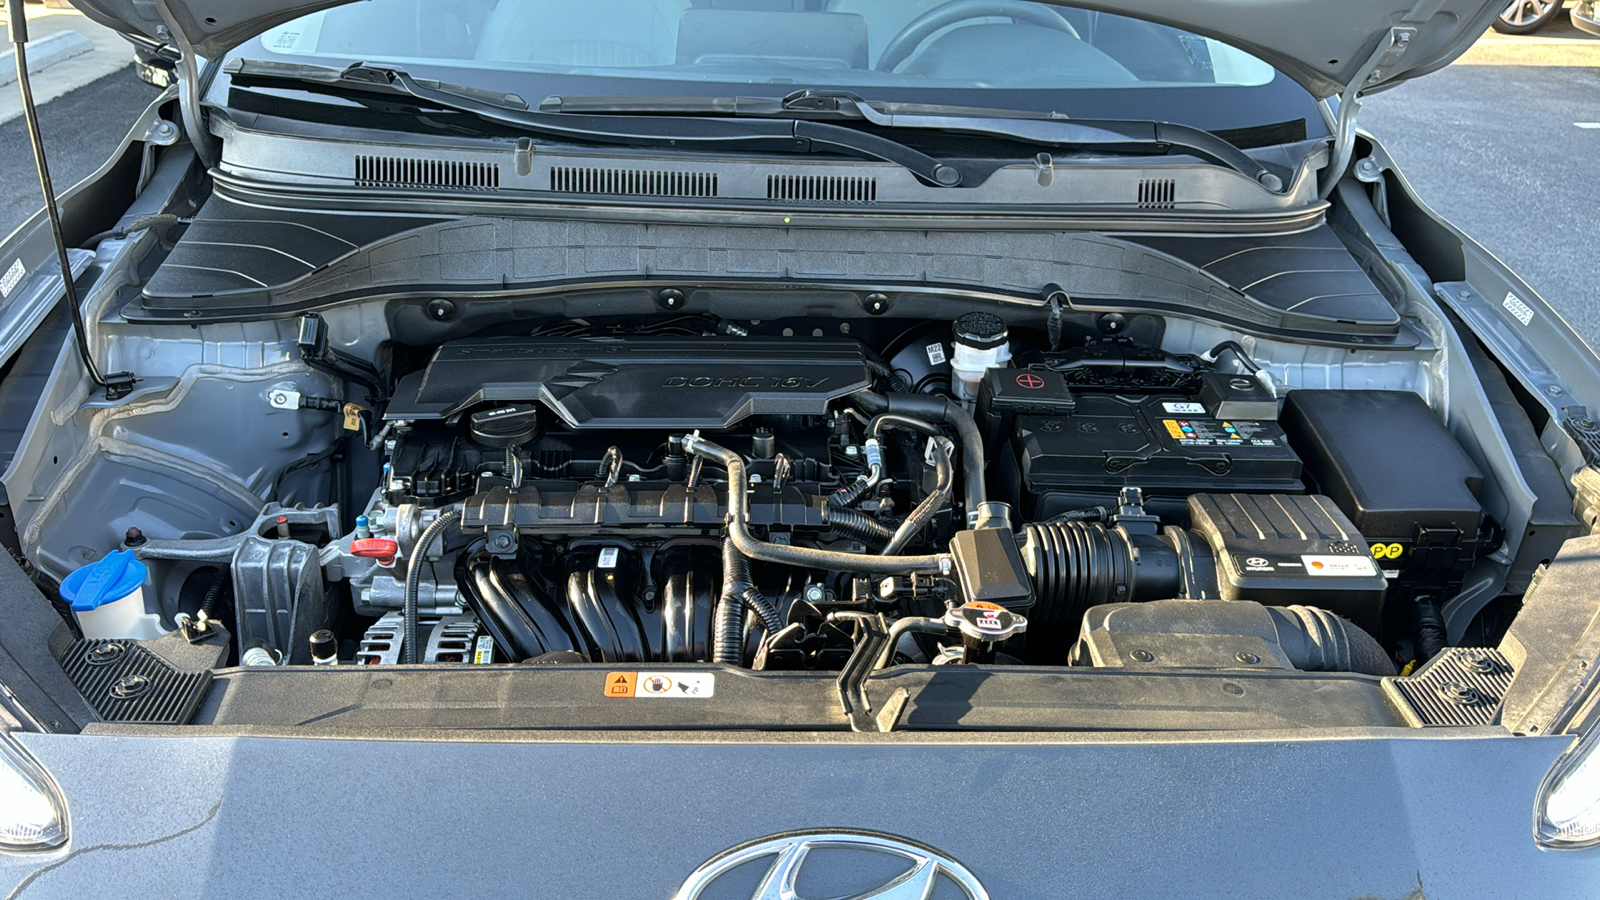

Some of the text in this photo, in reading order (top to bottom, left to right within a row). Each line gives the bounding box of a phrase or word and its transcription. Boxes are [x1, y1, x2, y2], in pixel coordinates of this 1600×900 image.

[927, 343, 941, 353] M22
[662, 376, 830, 388] DOHC 16V
[1373, 546, 1400, 557] P P
